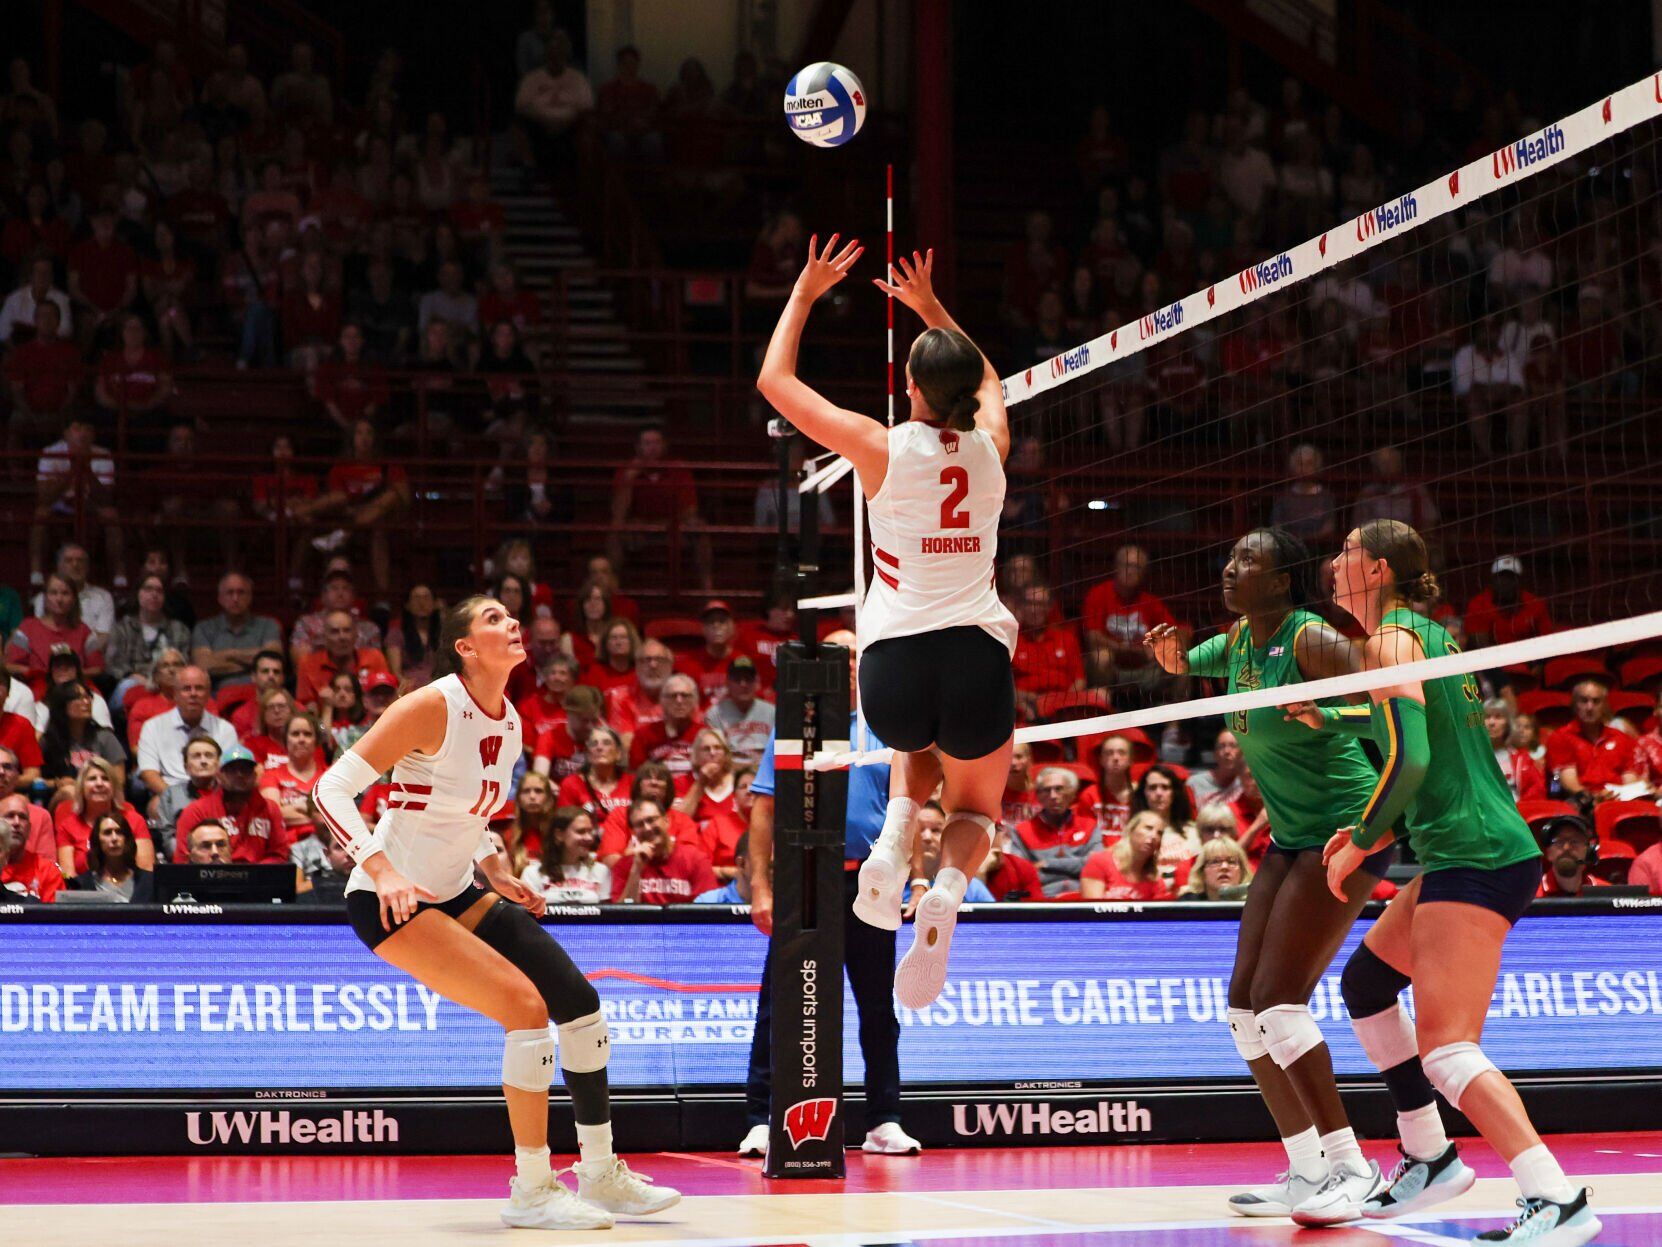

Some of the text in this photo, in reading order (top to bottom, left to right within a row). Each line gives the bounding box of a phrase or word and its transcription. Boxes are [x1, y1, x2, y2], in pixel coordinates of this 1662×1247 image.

[786, 98, 824, 111] molten
[791, 112, 823, 128] NCAA
[1239, 252, 1293, 295] UWHeath
[940, 466, 969, 528] 2
[921, 537, 980, 553] HORNER
[479, 736, 503, 770] W
[469, 779, 500, 817] 17
[163, 905, 223, 914] UWHealth
[1, 984, 440, 1032] DREAM FEARLESSLY
[601, 999, 683, 1021] RICAN
[1051, 978, 1228, 1025] CAREFUL
[1487, 971, 1662, 1018] ARLESSL
[609, 1025, 748, 1039] SURANC
[800, 959, 818, 1088] sports imports
[1014, 1081, 1082, 1089] DAKTRONICS
[185, 1110, 399, 1145] UWHealth
[952, 1101, 1152, 1136] UWHealth
